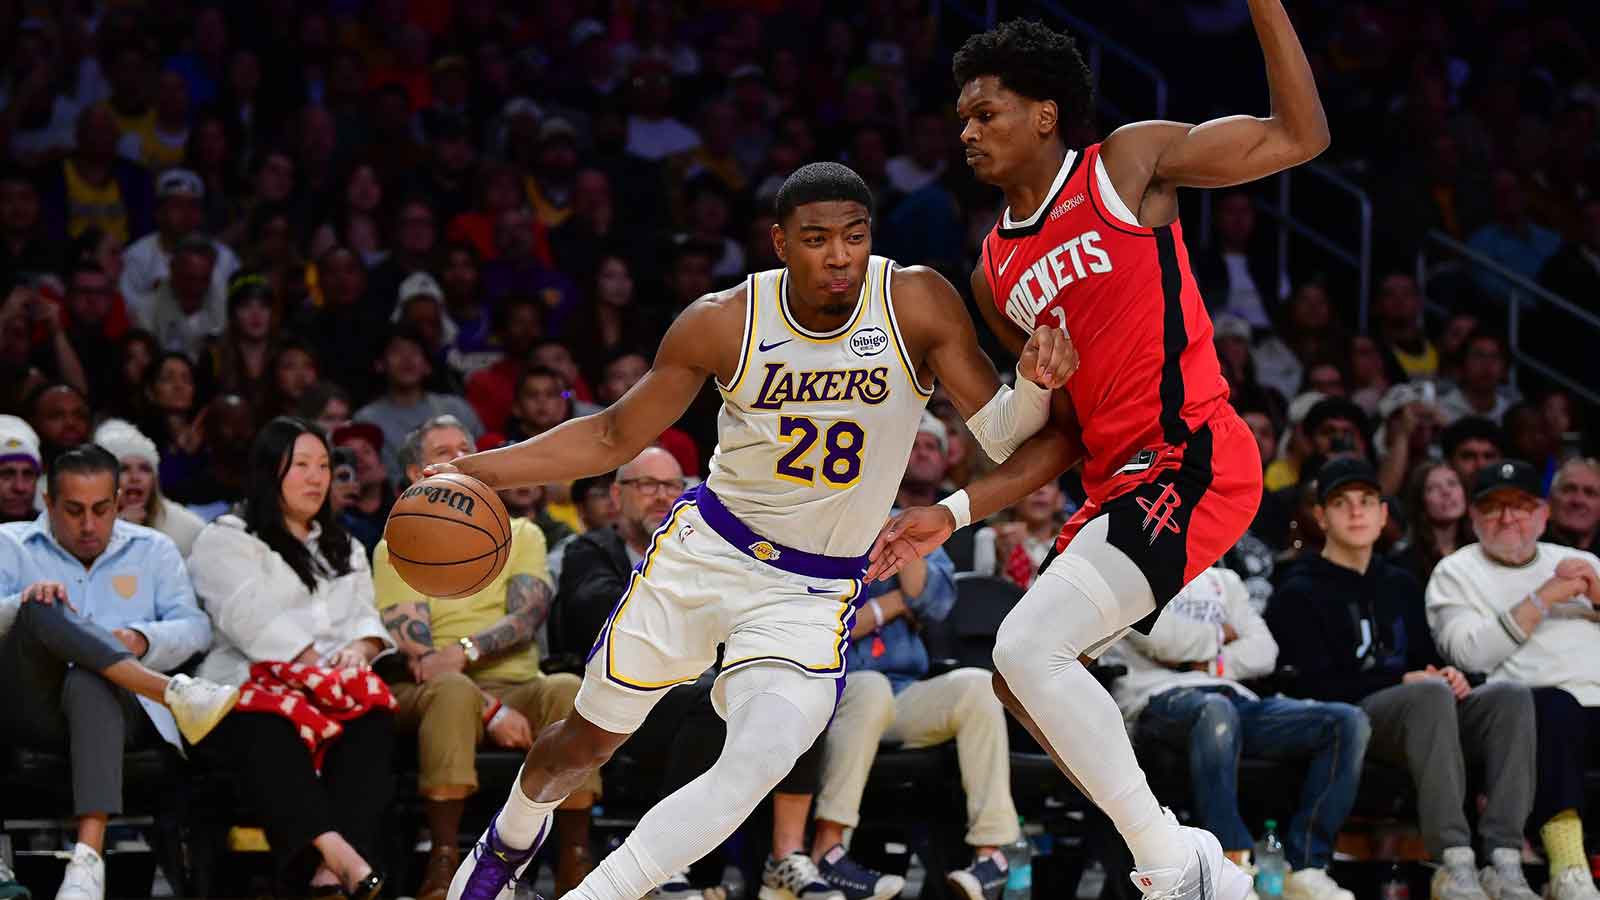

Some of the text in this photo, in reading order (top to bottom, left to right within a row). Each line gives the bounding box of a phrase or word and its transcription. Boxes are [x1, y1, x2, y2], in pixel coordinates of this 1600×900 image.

[1005, 230, 1113, 337] ROCKETS
[853, 335, 886, 348] bibigo
[750, 362, 890, 410] LAKERS
[774, 414, 866, 490] 28
[400, 486, 475, 516] Wilson
